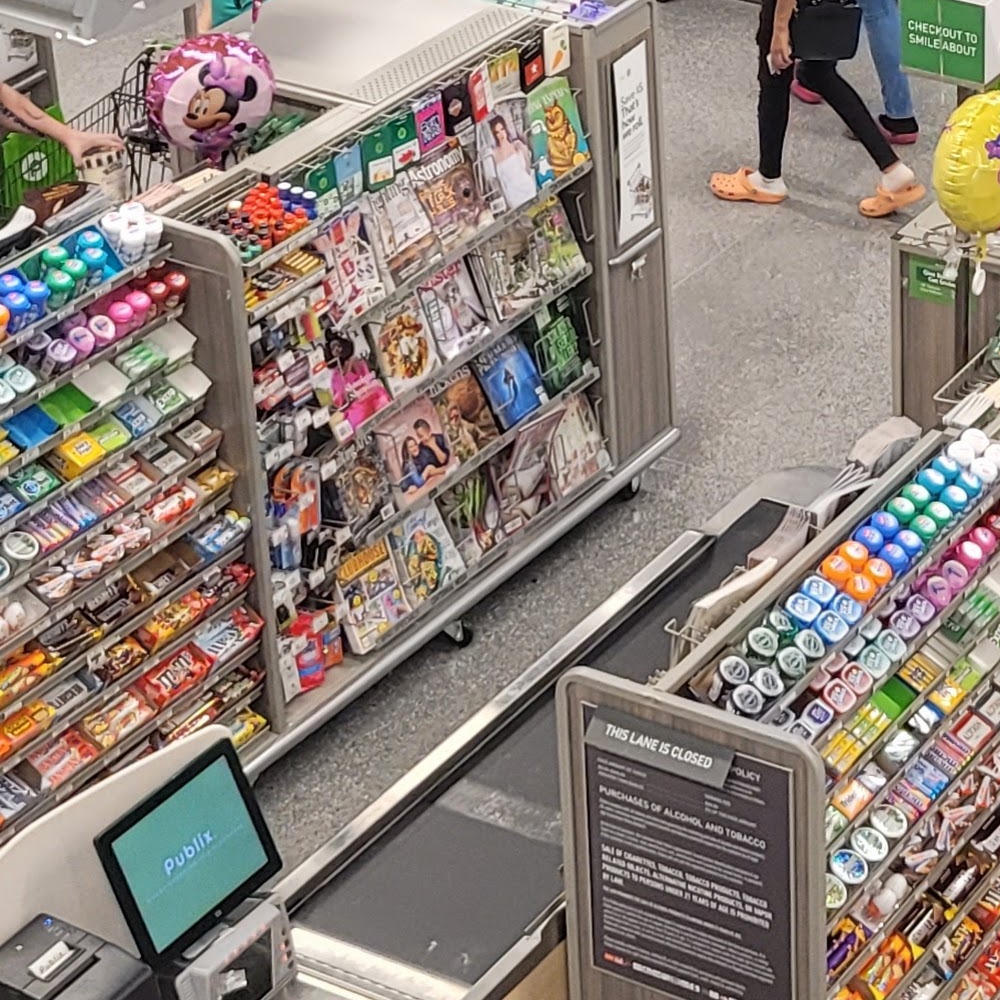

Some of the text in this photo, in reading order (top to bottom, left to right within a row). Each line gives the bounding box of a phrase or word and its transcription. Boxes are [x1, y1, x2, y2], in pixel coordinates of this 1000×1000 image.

[908, 20, 978, 44] CHECKOUT TO
[908, 34, 977, 58] SMILE ABOUT
[408, 147, 465, 186] Astronomy
[605, 723, 713, 769] THIS LANE IS CLOSED
[599, 785, 650, 811] PURCHASES
[651, 802, 663, 814] OF
[663, 805, 703, 828] ALCOHOL
[705, 822, 724, 836] AND
[725, 828, 767, 850] TOBACCO
[163, 828, 215, 877] Publix
